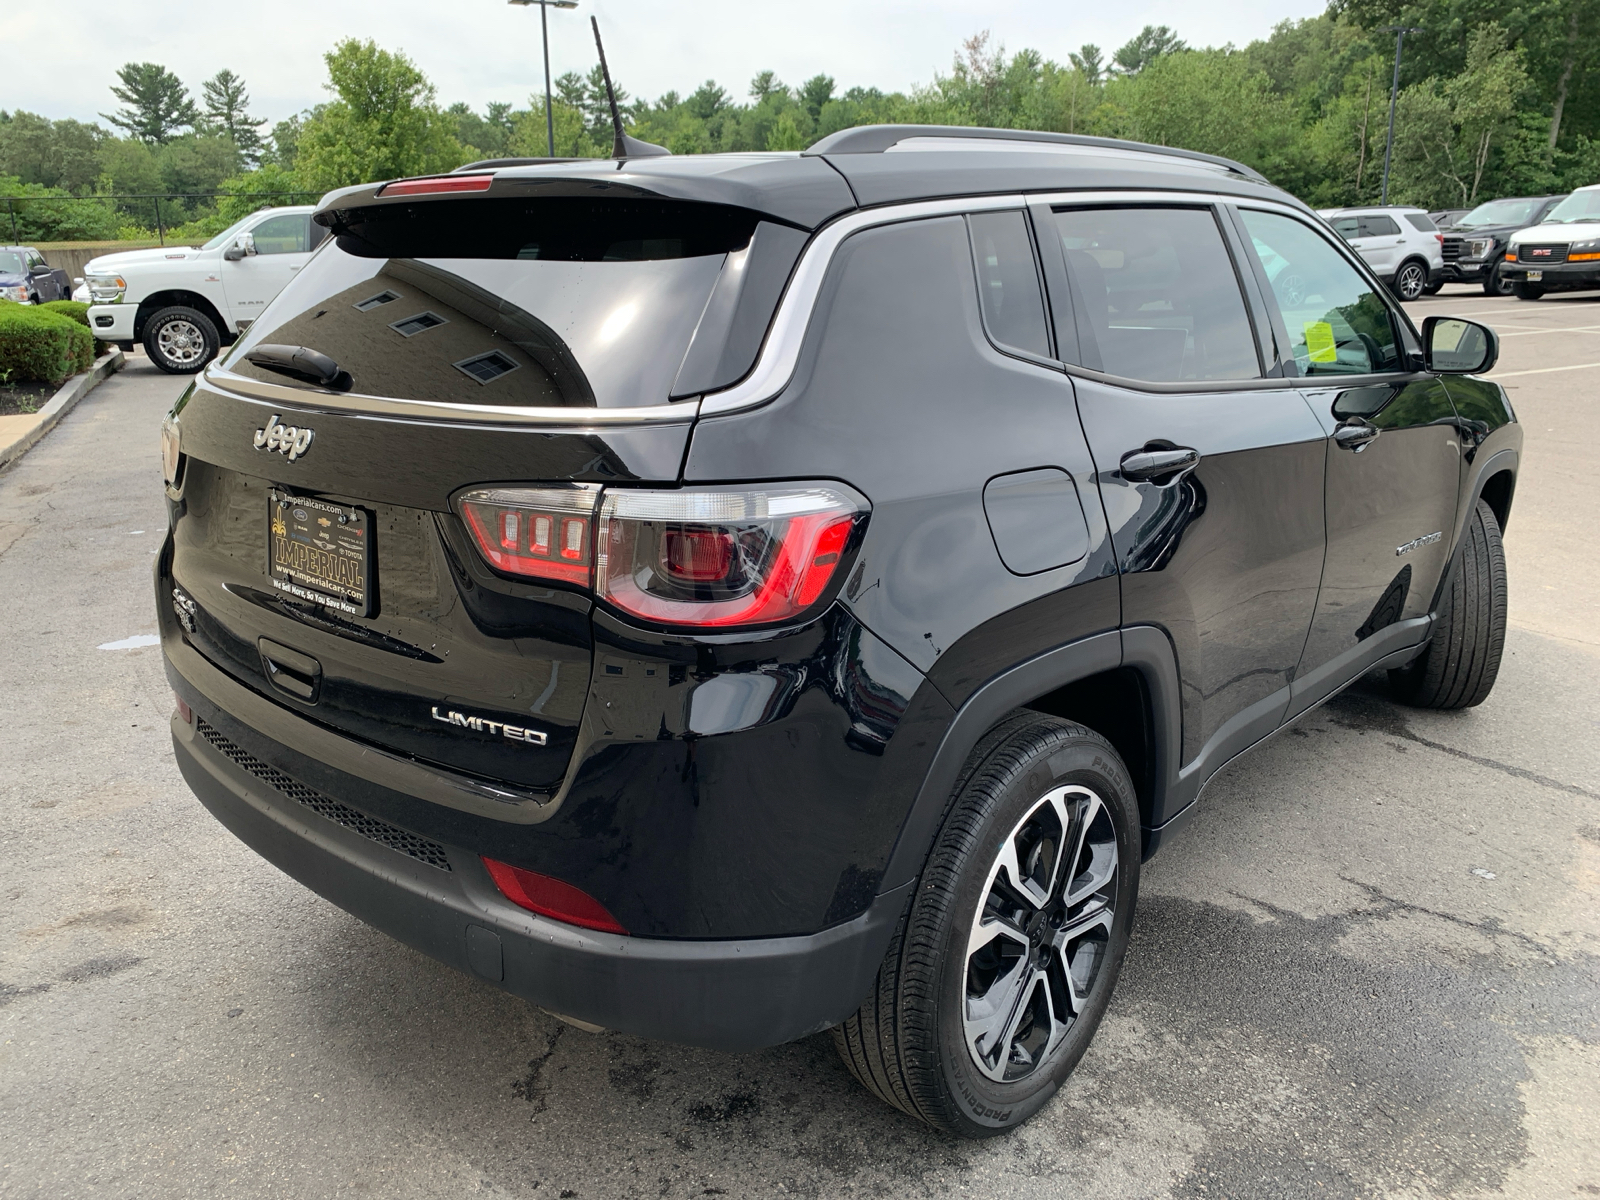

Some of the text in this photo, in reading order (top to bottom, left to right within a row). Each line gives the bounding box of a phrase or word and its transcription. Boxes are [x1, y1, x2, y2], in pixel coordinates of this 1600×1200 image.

[253, 413, 316, 464] Jeep
[282, 493, 343, 515] Imperialcars.com
[275, 536, 364, 591] IMPERIAL
[344, 549, 363, 561] TOYOTA
[273, 579, 356, 614] We Sell More, So You Save More
[275, 564, 364, 600] www.imperialcars.com
[431, 706, 548, 746] LIMITED
